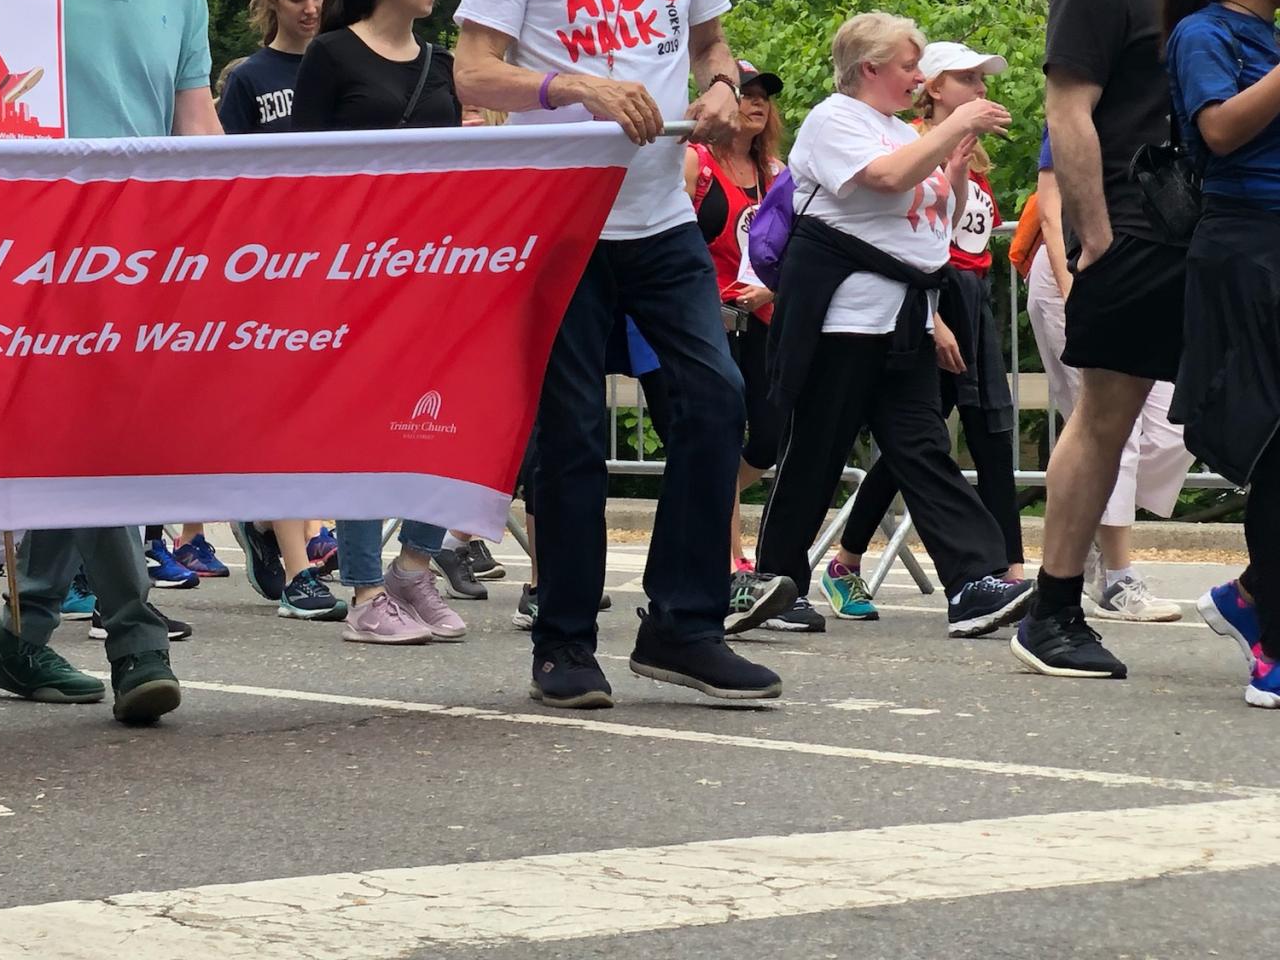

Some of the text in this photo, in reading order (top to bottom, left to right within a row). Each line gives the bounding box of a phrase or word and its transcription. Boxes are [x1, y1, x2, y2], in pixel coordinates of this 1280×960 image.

[665, 0, 681, 36] YORK
[556, 10, 666, 63] WALK
[657, 38, 680, 56] 2019
[962, 212, 985, 234] 23
[12, 245, 157, 286] AIDS
[160, 246, 210, 283] In
[223, 244, 319, 283] Our
[325, 235, 538, 280] Lifetime!
[134, 321, 224, 354] Wall
[228, 320, 350, 352] Street
[390, 421, 457, 434] Trinity Church
